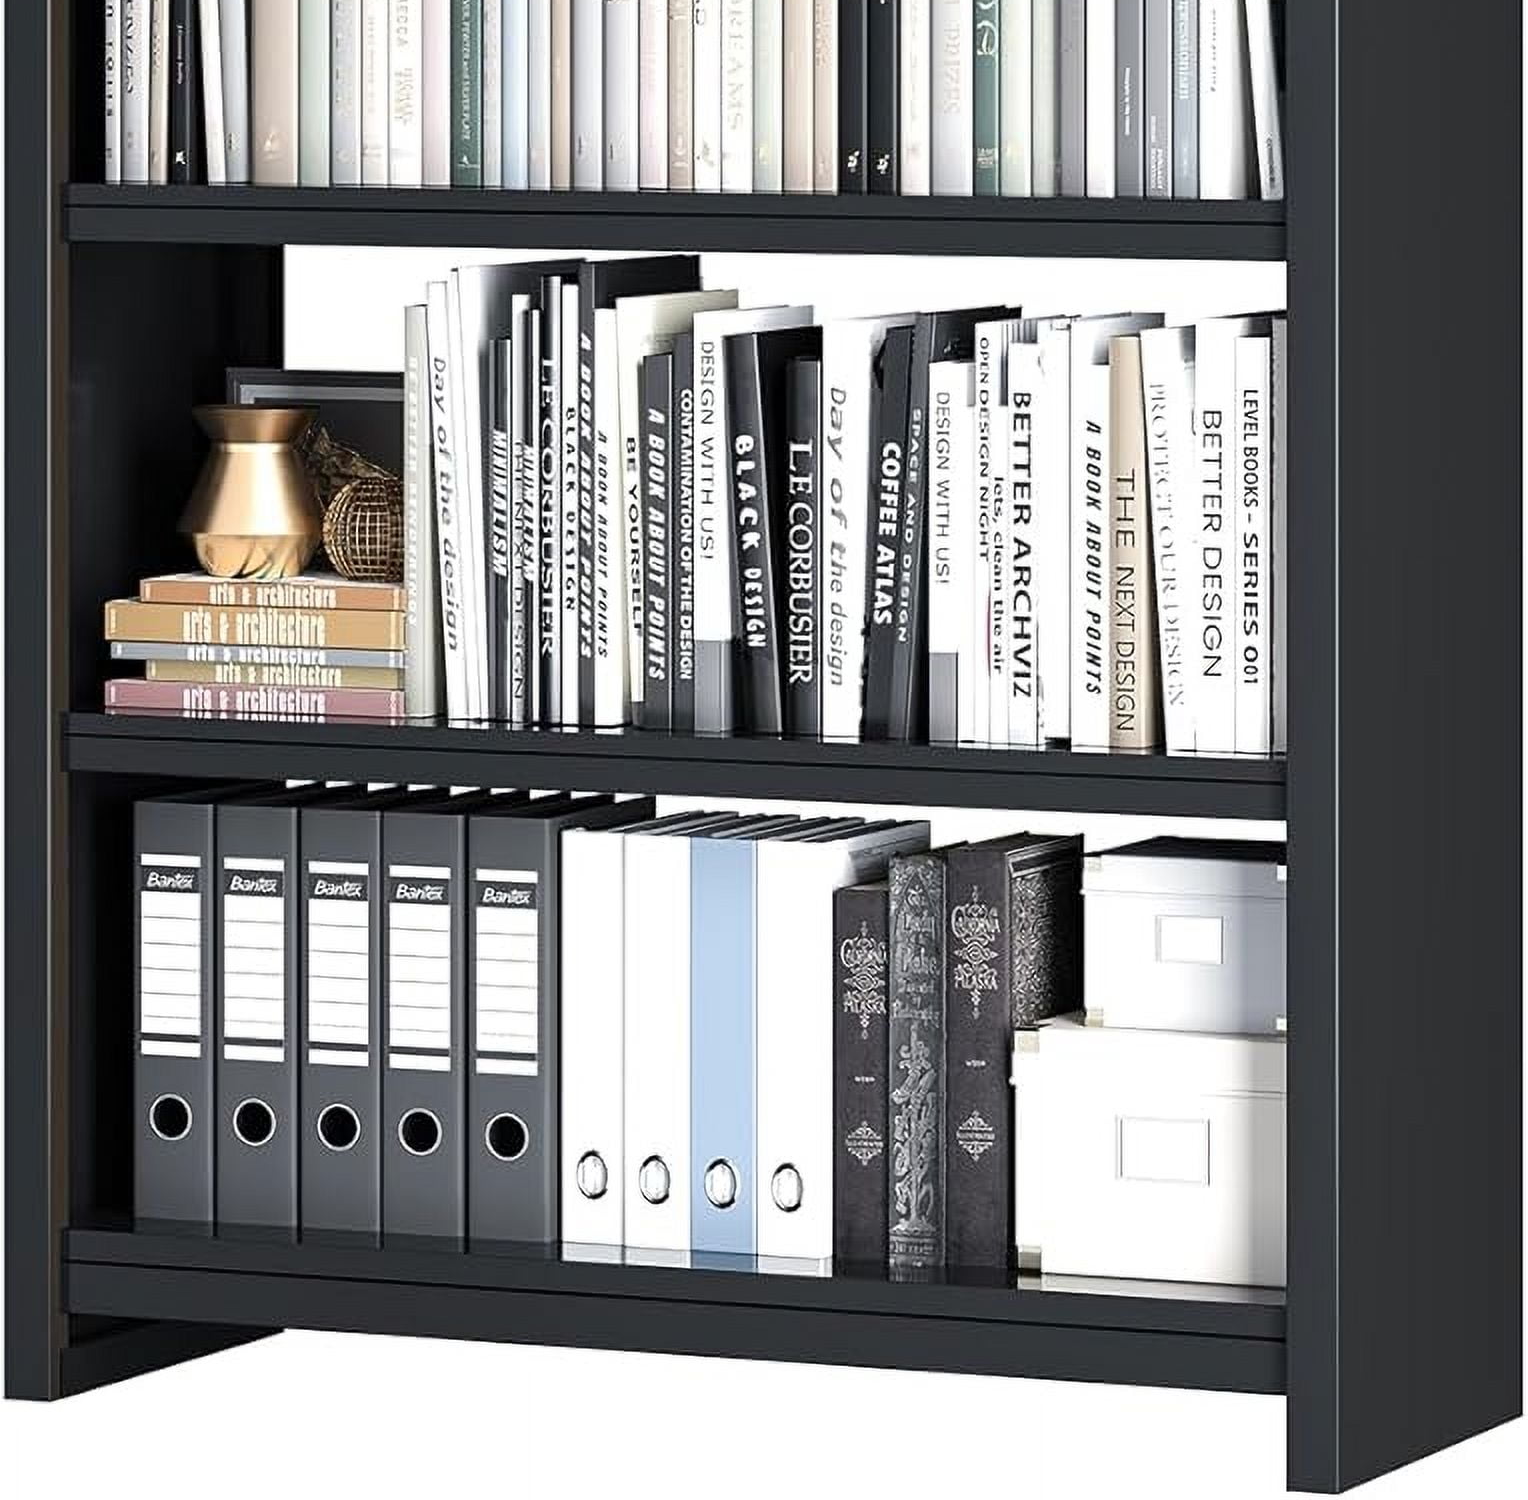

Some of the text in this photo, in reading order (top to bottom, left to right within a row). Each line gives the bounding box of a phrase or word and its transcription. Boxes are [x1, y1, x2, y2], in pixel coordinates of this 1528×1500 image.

[434, 357, 460, 651] Day of the design
[492, 428, 508, 578] MINIMALISM
[541, 359, 556, 655] LE CORBUSIER
[566, 407, 576, 492] BLACK
[580, 333, 593, 658] A BOOK ABOUT POINTS
[598, 431, 608, 658] A BOOK ABOUT POINTS
[626, 437, 636, 472] BE
[649, 409, 665, 681] A BOOK ABOUT POINTS
[680, 389, 693, 680] CONTAMINATION OF THE DESIGN
[700, 342, 714, 560] DESIGN WITH US!
[735, 434, 767, 647] BLACK DESIGN
[828, 388, 848, 686] Day of the design
[874, 442, 901, 625] COFFEE ATLAS
[898, 408, 922, 642] SPACE AND DESIGN
[935, 392, 950, 583] DESIGN WITH US!
[979, 337, 989, 562] OPEN DESIGN NIGHT
[1013, 393, 1032, 697] BETTER ARCHVIZ
[1202, 410, 1222, 677] BETTER DESIGN
[1243, 390, 1258, 684] LEVEL BOOKS SERIES 001
[183, 606, 326, 646] arts & architecture
[210, 583, 236, 598] arts
[256, 584, 337, 608] architecture
[239, 646, 326, 665] architecture
[789, 439, 813, 684] LE CORBUSIER
[993, 530, 1004, 592] clean
[993, 643, 1005, 674] air
[1086, 420, 1101, 695] A BOOK ABOUT POINTS
[1116, 468, 1134, 731] THE NEXT DESIGN
[183, 685, 326, 714] arts & architecture
[215, 662, 241, 682] arts
[261, 663, 342, 687] architecture
[147, 872, 194, 890] Bantex
[229, 875, 278, 893] Bantex
[314, 880, 362, 898] Bantex
[396, 883, 444, 901] Bantex
[482, 888, 530, 906] Bantex
